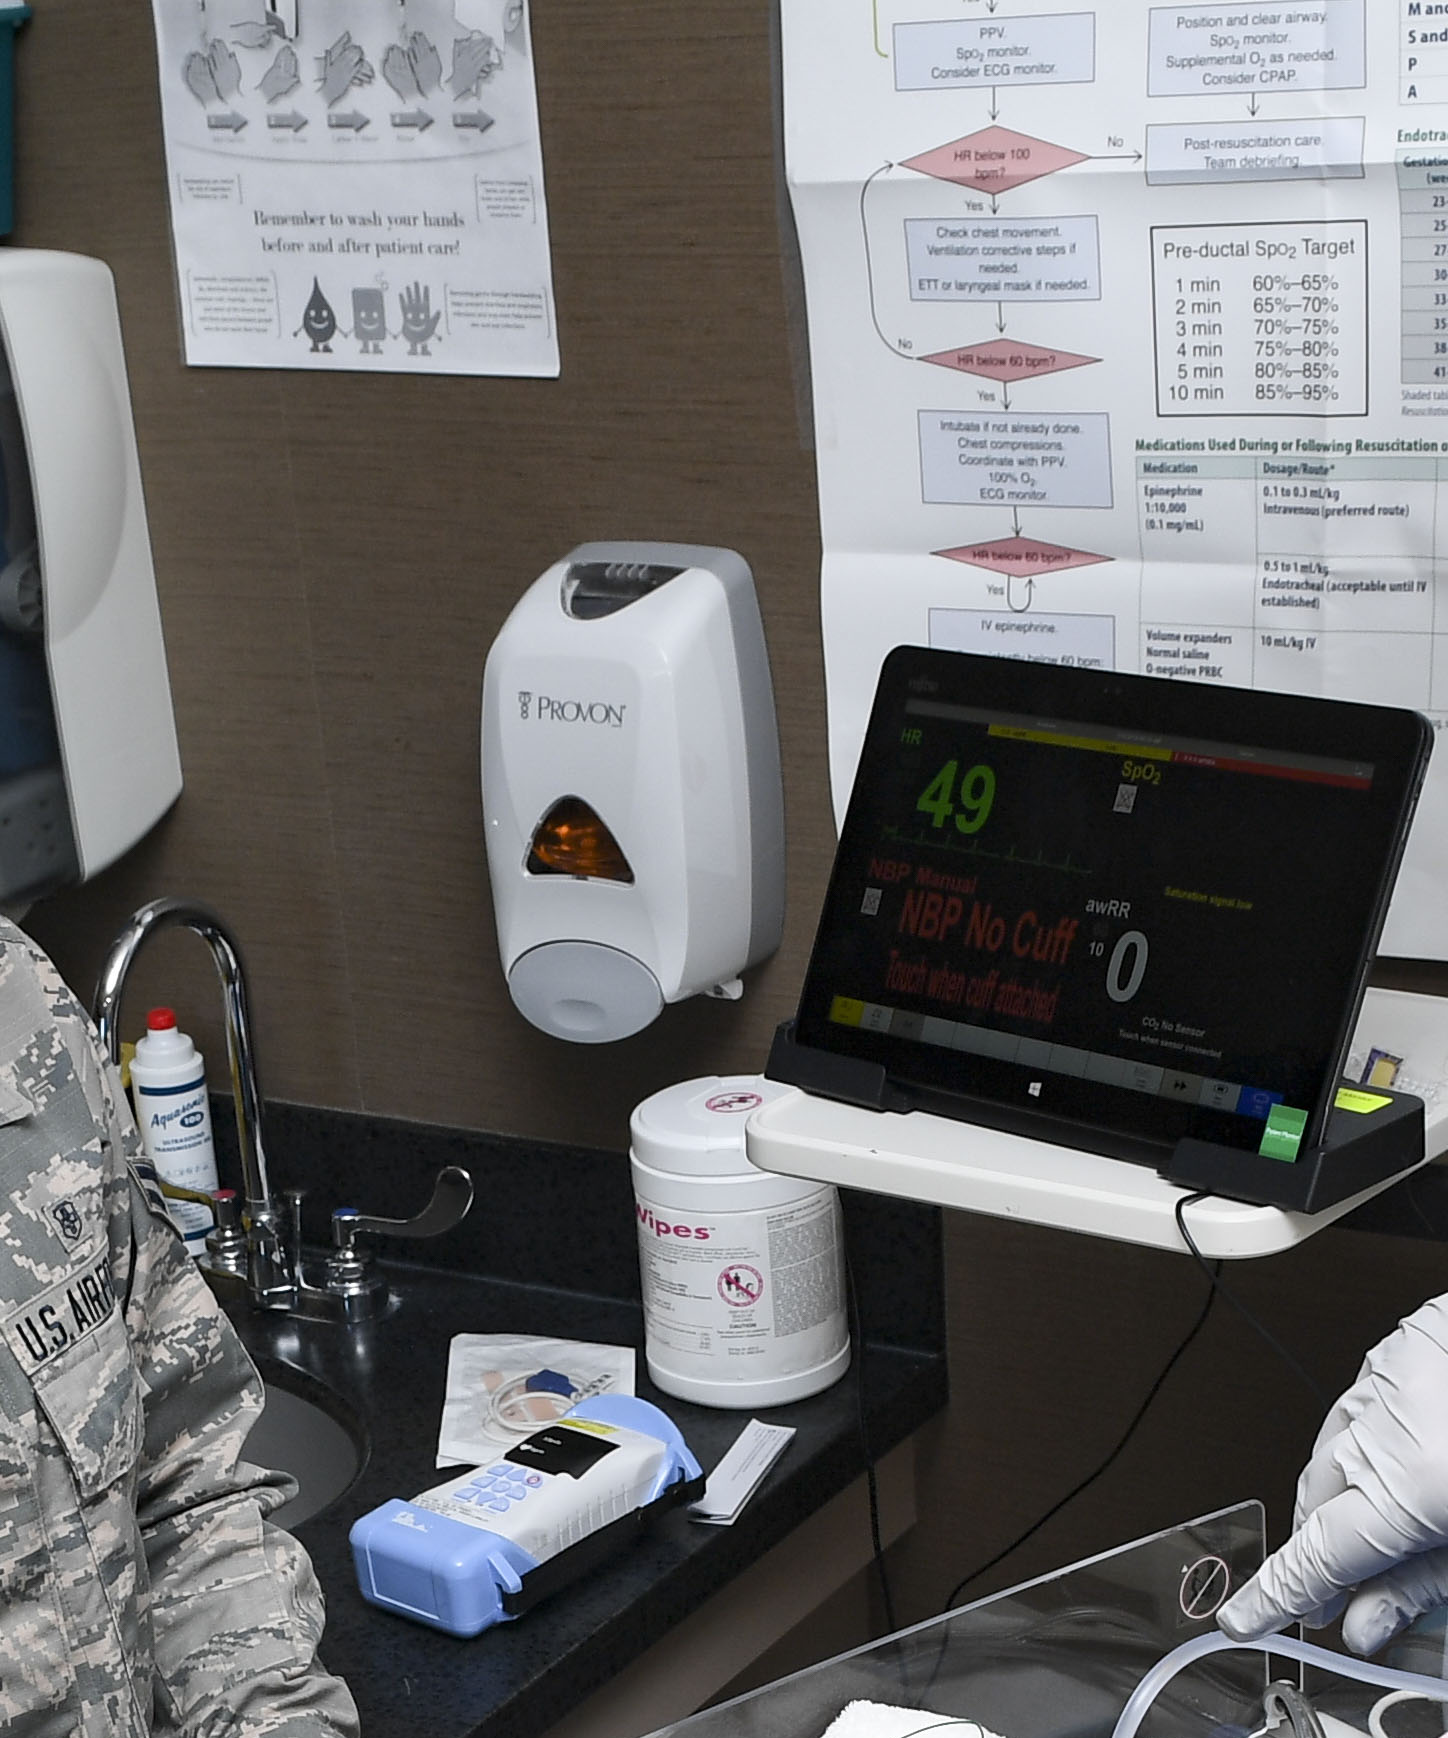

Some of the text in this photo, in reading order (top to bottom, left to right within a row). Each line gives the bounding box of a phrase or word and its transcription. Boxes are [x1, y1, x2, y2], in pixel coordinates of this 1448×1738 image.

[1408, 3, 1421, 16] M
[1177, 13, 1281, 28] Position and clear
[1420, 28, 1447, 42] and
[1166, 53, 1245, 69] Supplemental
[931, 64, 1010, 79] Consider ECG
[1202, 72, 1255, 85] Consider
[1108, 136, 1124, 148] No
[1184, 135, 1291, 150] Post-resuscitation
[953, 148, 1030, 162] HR below 100
[1204, 156, 1236, 168] Team
[254, 209, 465, 231] Remember to wash your hands
[937, 227, 999, 238] Check chest
[261, 237, 303, 252] before
[308, 237, 333, 252] and
[338, 238, 370, 254] after
[375, 238, 423, 258] patient
[927, 244, 1066, 256] Ventilation steps
[1163, 238, 1355, 259] Pre-ductal Target
[919, 279, 1000, 293] ETT laryngeal
[1191, 277, 1220, 291] min
[1192, 298, 1221, 313] min
[1192, 320, 1221, 335] min
[1193, 342, 1222, 356] min
[1194, 363, 1223, 378] min
[1170, 385, 1188, 400] 10
[1194, 384, 1224, 400] min
[940, 420, 1049, 436] Intubate already
[958, 437, 987, 449] Chest
[1135, 439, 1205, 451] Medications
[1209, 439, 1236, 451] Used
[1239, 439, 1278, 454] During
[1296, 439, 1352, 455] Following
[1356, 439, 1438, 452] Resuscitation
[959, 455, 1038, 467] Coordinate with
[1143, 462, 1198, 473] Medication
[986, 584, 1003, 595] Yes
[538, 696, 623, 727] PROVON
[916, 759, 996, 834] 49
[1085, 897, 1131, 920] awRR
[898, 888, 1079, 965] NBP No Cuff
[1088, 941, 1105, 958] 10
[1105, 929, 1150, 1004] 0
